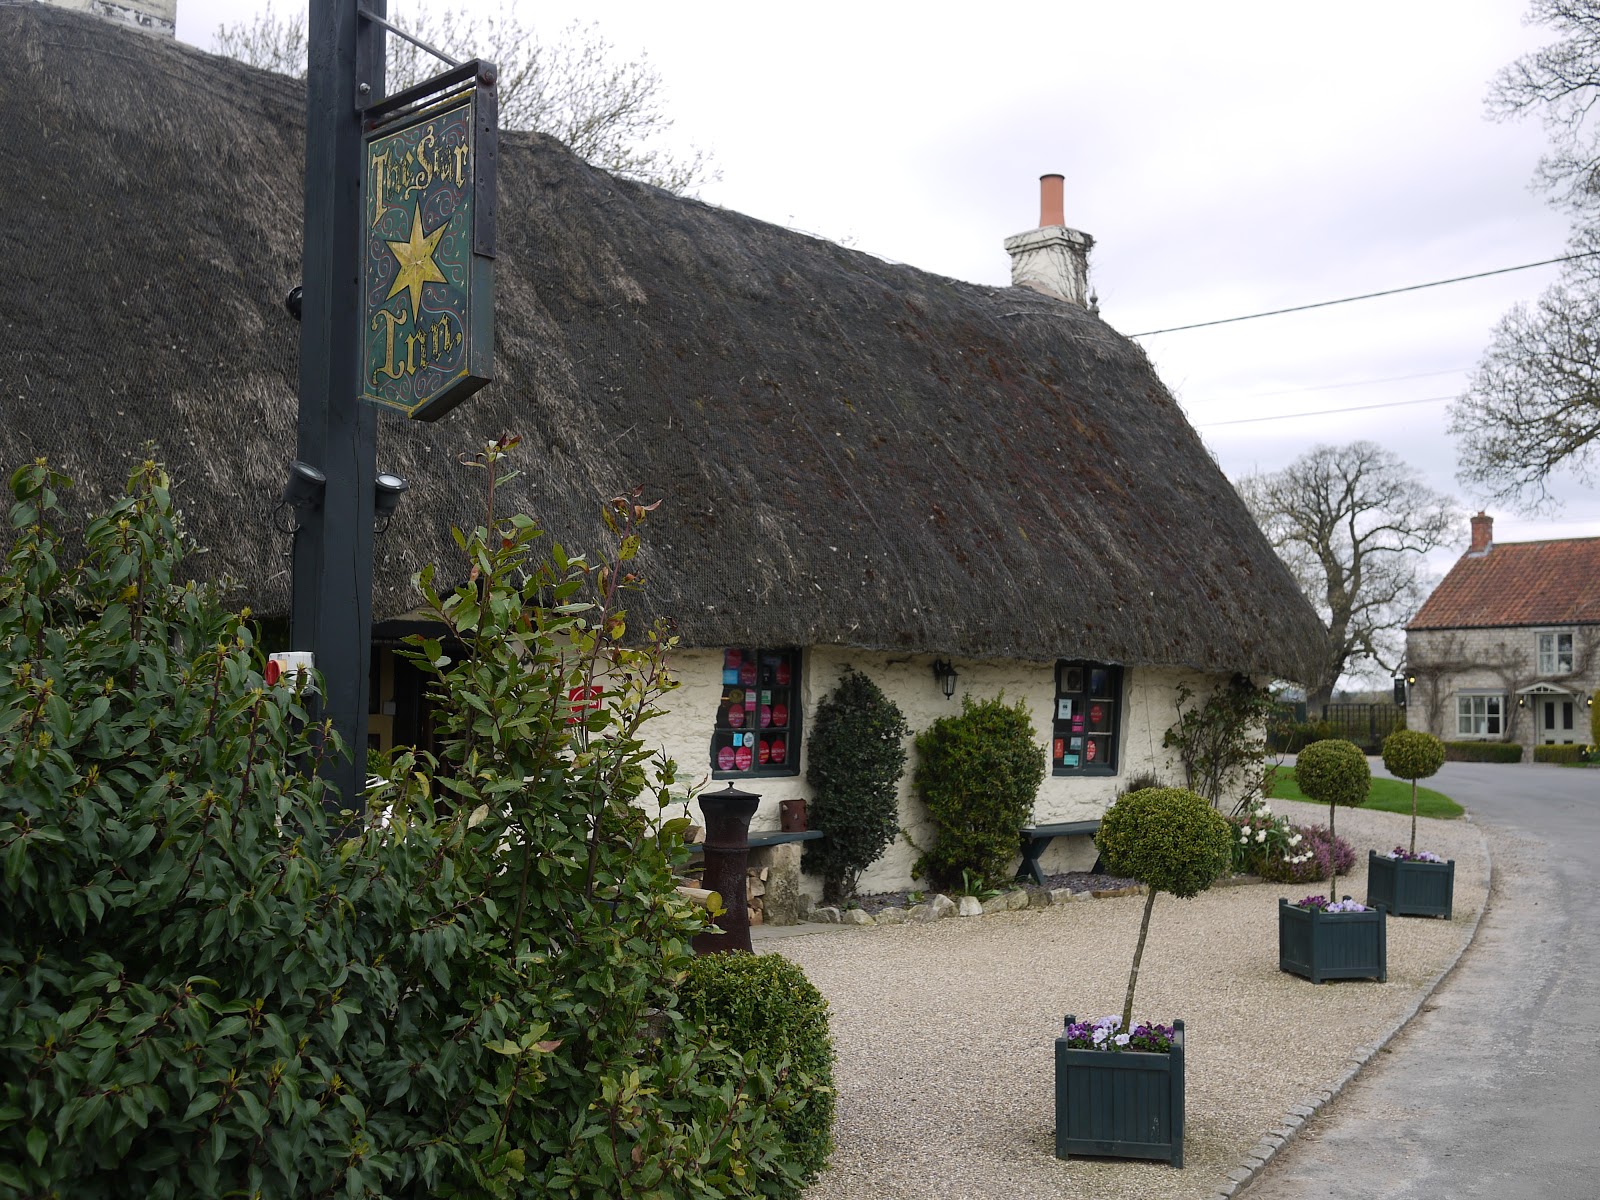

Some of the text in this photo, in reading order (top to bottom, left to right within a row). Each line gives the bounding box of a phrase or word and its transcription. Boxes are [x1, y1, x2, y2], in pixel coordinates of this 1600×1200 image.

[371, 125, 469, 229] The Star
[371, 309, 456, 385] Inn
